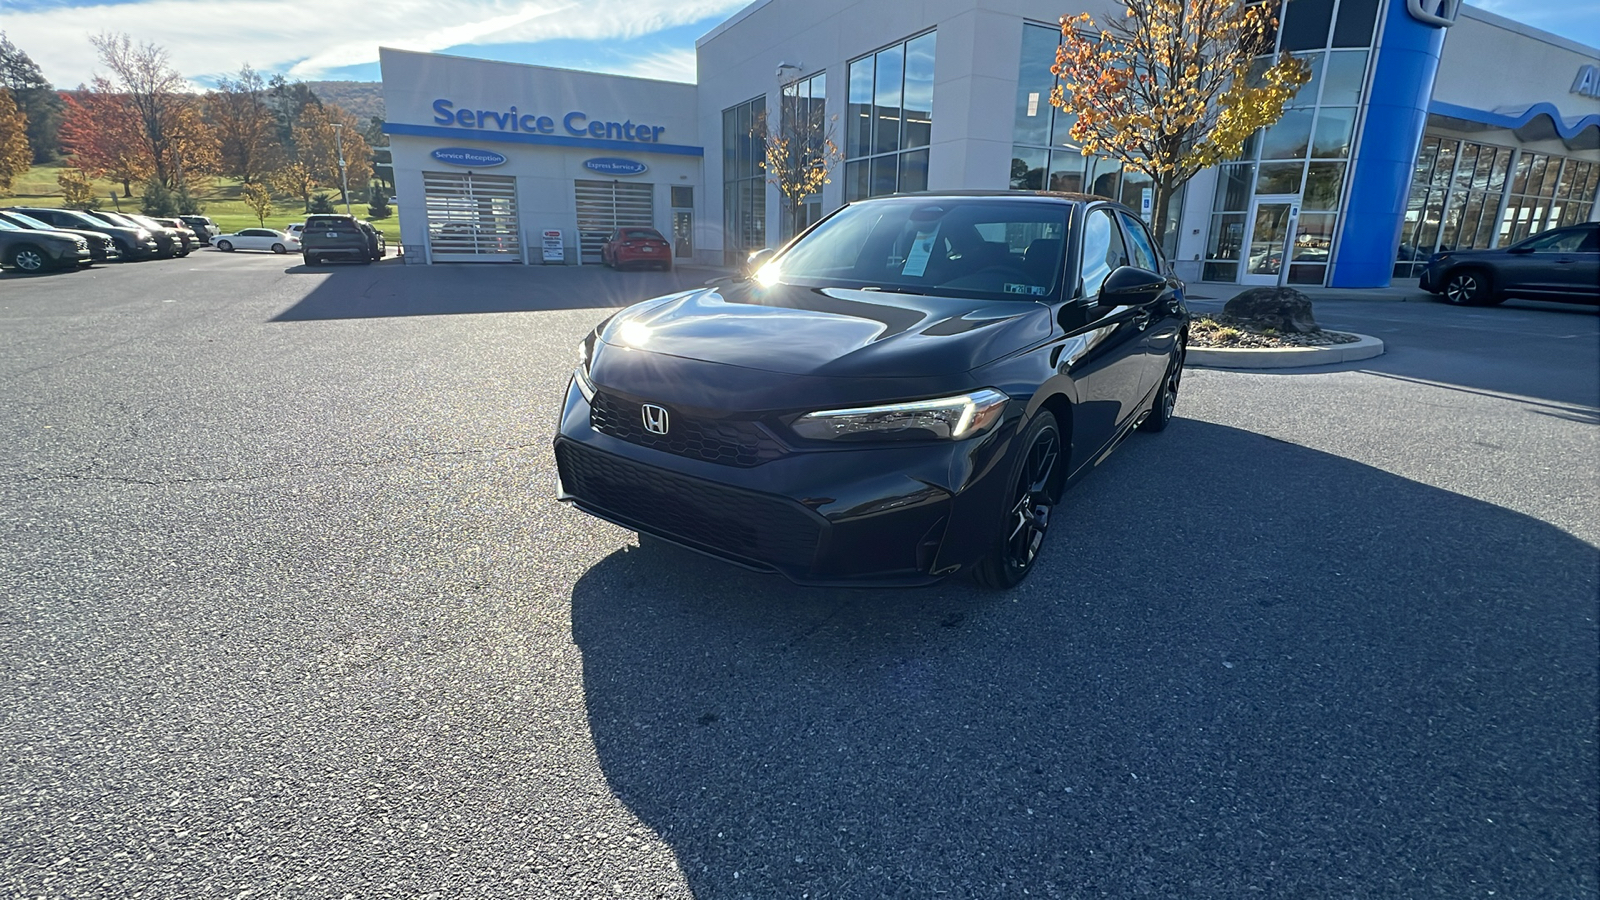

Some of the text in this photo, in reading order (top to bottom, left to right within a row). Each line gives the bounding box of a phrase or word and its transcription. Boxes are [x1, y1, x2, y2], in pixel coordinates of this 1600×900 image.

[432, 99, 665, 142] Service Center
[435, 151, 502, 162] Service Reception
[587, 161, 611, 169] Express
